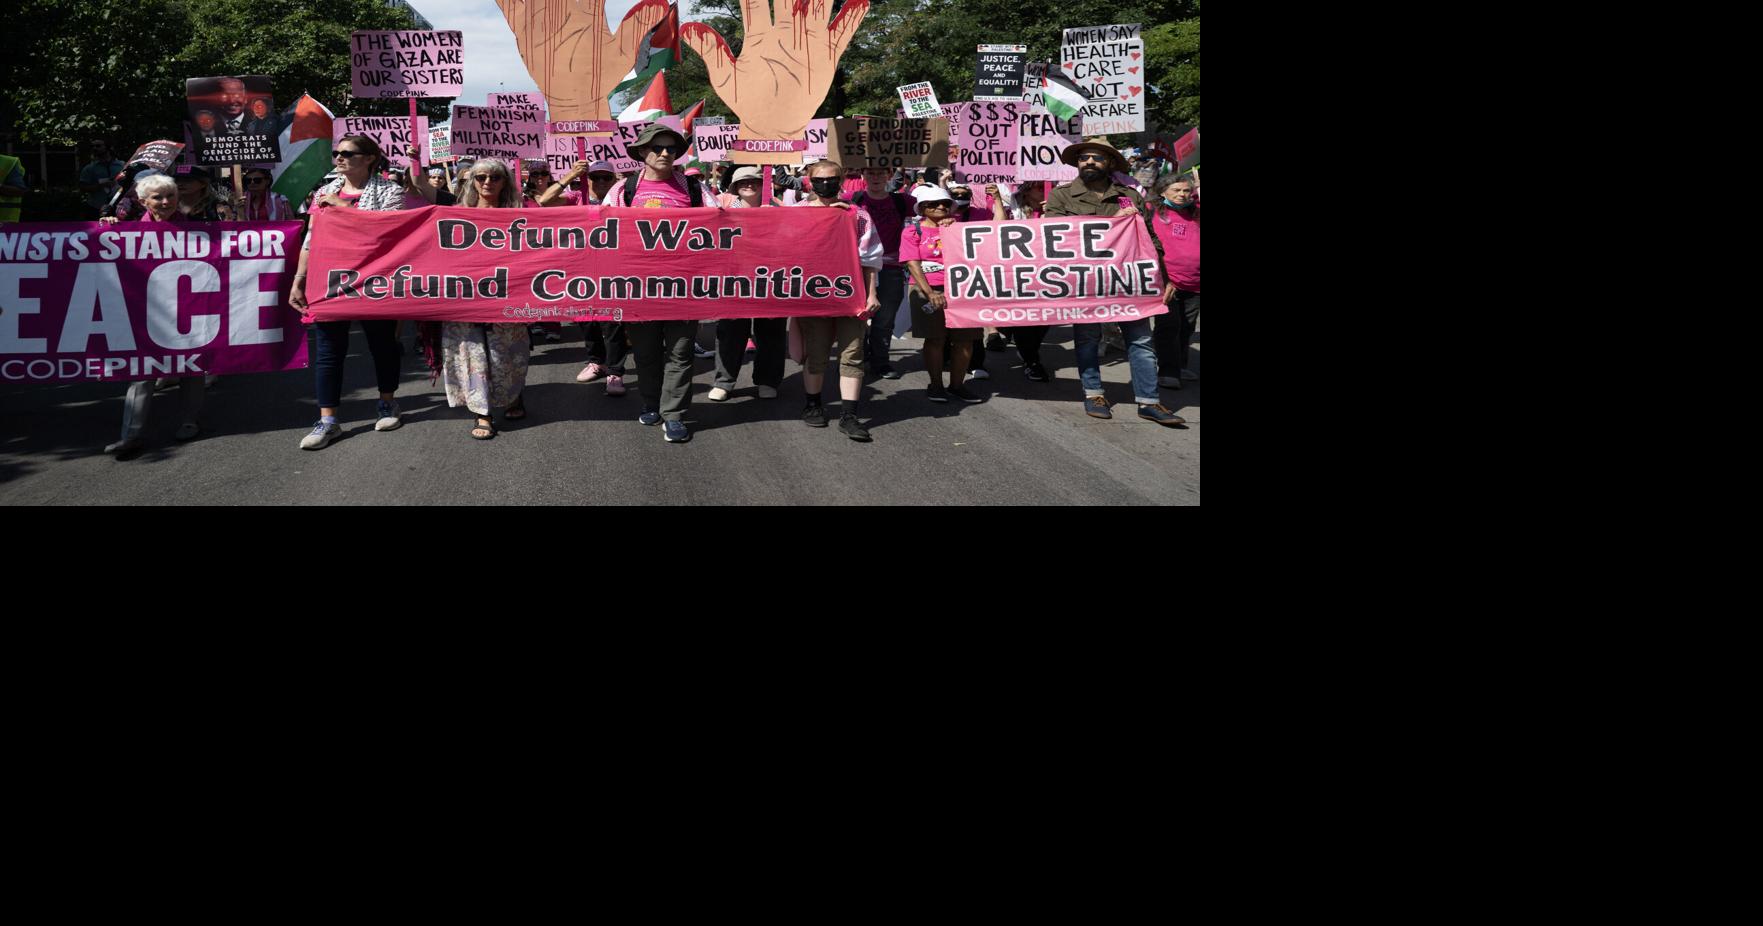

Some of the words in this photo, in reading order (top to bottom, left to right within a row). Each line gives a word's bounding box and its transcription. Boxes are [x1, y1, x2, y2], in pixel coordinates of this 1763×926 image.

[354, 34, 392, 52] THE
[397, 32, 462, 48] WOMEN
[1066, 28, 1107, 46] WOMEN
[1109, 25, 1138, 41] SAY
[354, 54, 372, 68] OF
[379, 50, 431, 69] GAZA
[436, 50, 463, 66] ARE
[984, 64, 1016, 72] PEACE.
[1074, 60, 1125, 80] CARE
[360, 70, 394, 87] OUR
[400, 68, 464, 84] SISTERS
[900, 84, 917, 92] FROM
[902, 88, 931, 100] RIVER
[1082, 82, 1124, 98] NOT
[497, 94, 530, 104] MAKE
[458, 106, 537, 122] FEMINISM
[912, 102, 932, 112] SEA
[1080, 103, 1139, 118] ARFARE
[480, 120, 513, 132] NOT
[556, 121, 600, 132] CODEPINK
[856, 118, 924, 130] FUNDING
[968, 123, 1012, 138] OUT
[1020, 112, 1080, 137] PEACE
[205, 135, 267, 143] DEMOCRATS
[452, 131, 540, 148] MILITARISM
[845, 129, 932, 142] GENOCIDE
[555, 138, 566, 152] IS
[746, 140, 794, 151] CODEPINK
[844, 144, 866, 155] IS
[878, 142, 931, 155] WEIRD
[974, 138, 1000, 150] OF
[202, 153, 276, 162] PALESTINIANS
[203, 148, 255, 156] GENOCIDE
[466, 148, 519, 158] CODEPINK
[865, 156, 903, 167] TOO
[965, 173, 1016, 184] CODEPINK
[437, 217, 620, 252] Defund
[635, 218, 742, 252] War
[964, 221, 1116, 261] FREE
[98, 230, 211, 260] STAND
[220, 230, 286, 258] FOR
[325, 265, 508, 300] Refund
[530, 266, 855, 301] Communities
[949, 260, 1160, 300] PALESTINE
[978, 304, 1140, 322] CODEPINK.ORG
[1, 354, 204, 380] CODEPINK
